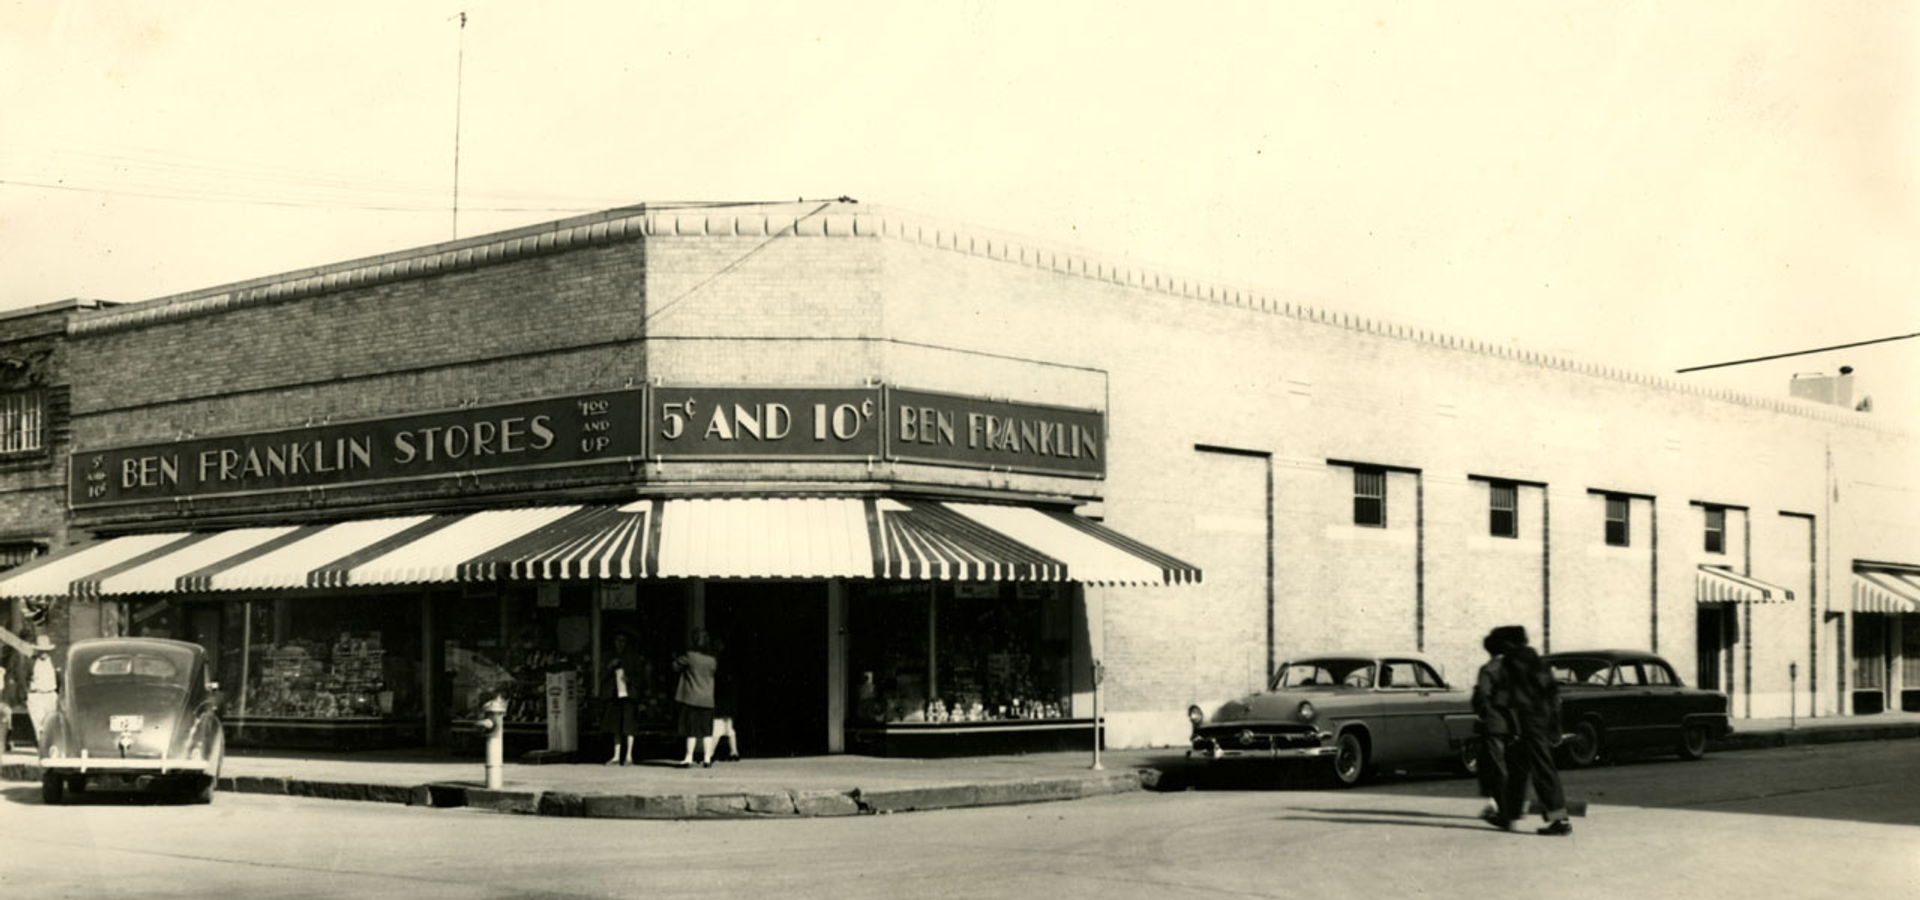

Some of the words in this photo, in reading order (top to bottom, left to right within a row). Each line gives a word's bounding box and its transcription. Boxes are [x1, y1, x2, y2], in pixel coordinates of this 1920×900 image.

[582, 420, 611, 432] AND
[704, 403, 792, 440] AND
[900, 404, 955, 446] BEN
[968, 412, 1098, 459] FRANKLIN
[121, 454, 179, 489] BEN
[199, 436, 371, 483] FRANKLIN
[394, 414, 555, 465] STORES
[581, 436, 610, 453] UP
